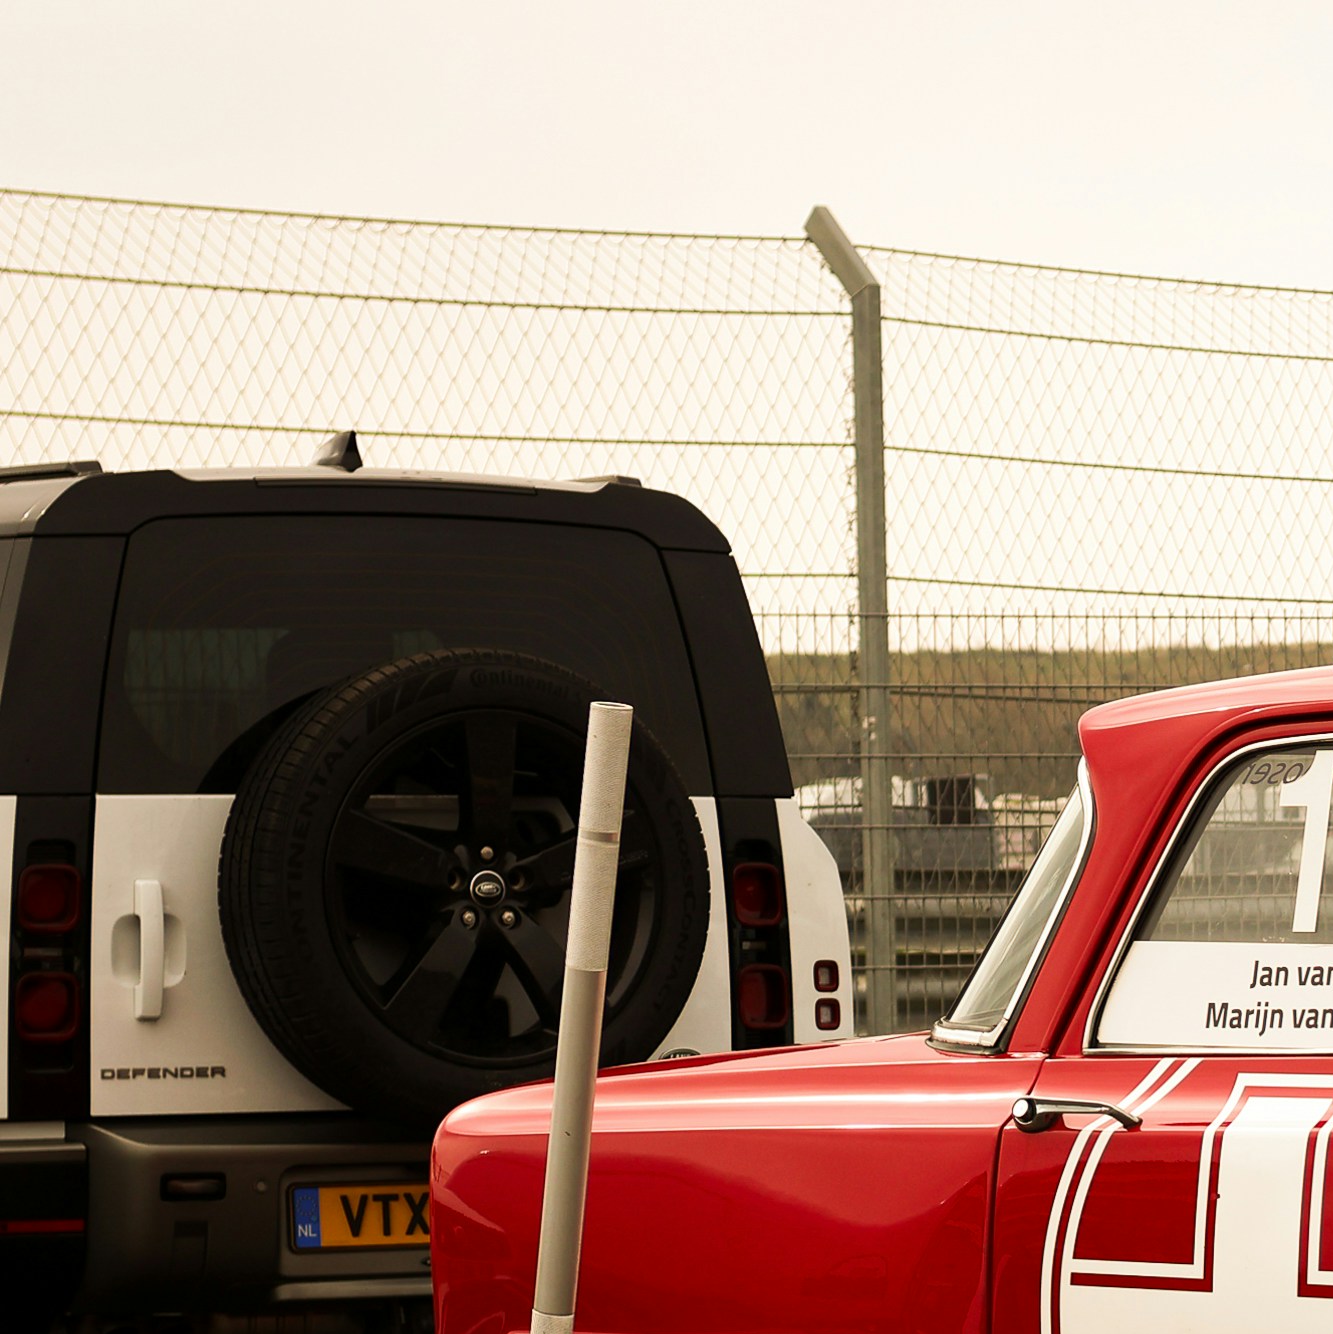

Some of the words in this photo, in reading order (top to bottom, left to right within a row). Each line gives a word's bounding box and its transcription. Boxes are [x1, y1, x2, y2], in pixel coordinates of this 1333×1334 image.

[1250, 960, 1289, 989] Jan
[1205, 1001, 1284, 1036] Marijn
[100, 1066, 227, 1080] DEFENDER
[297, 1223, 318, 1238] NL
